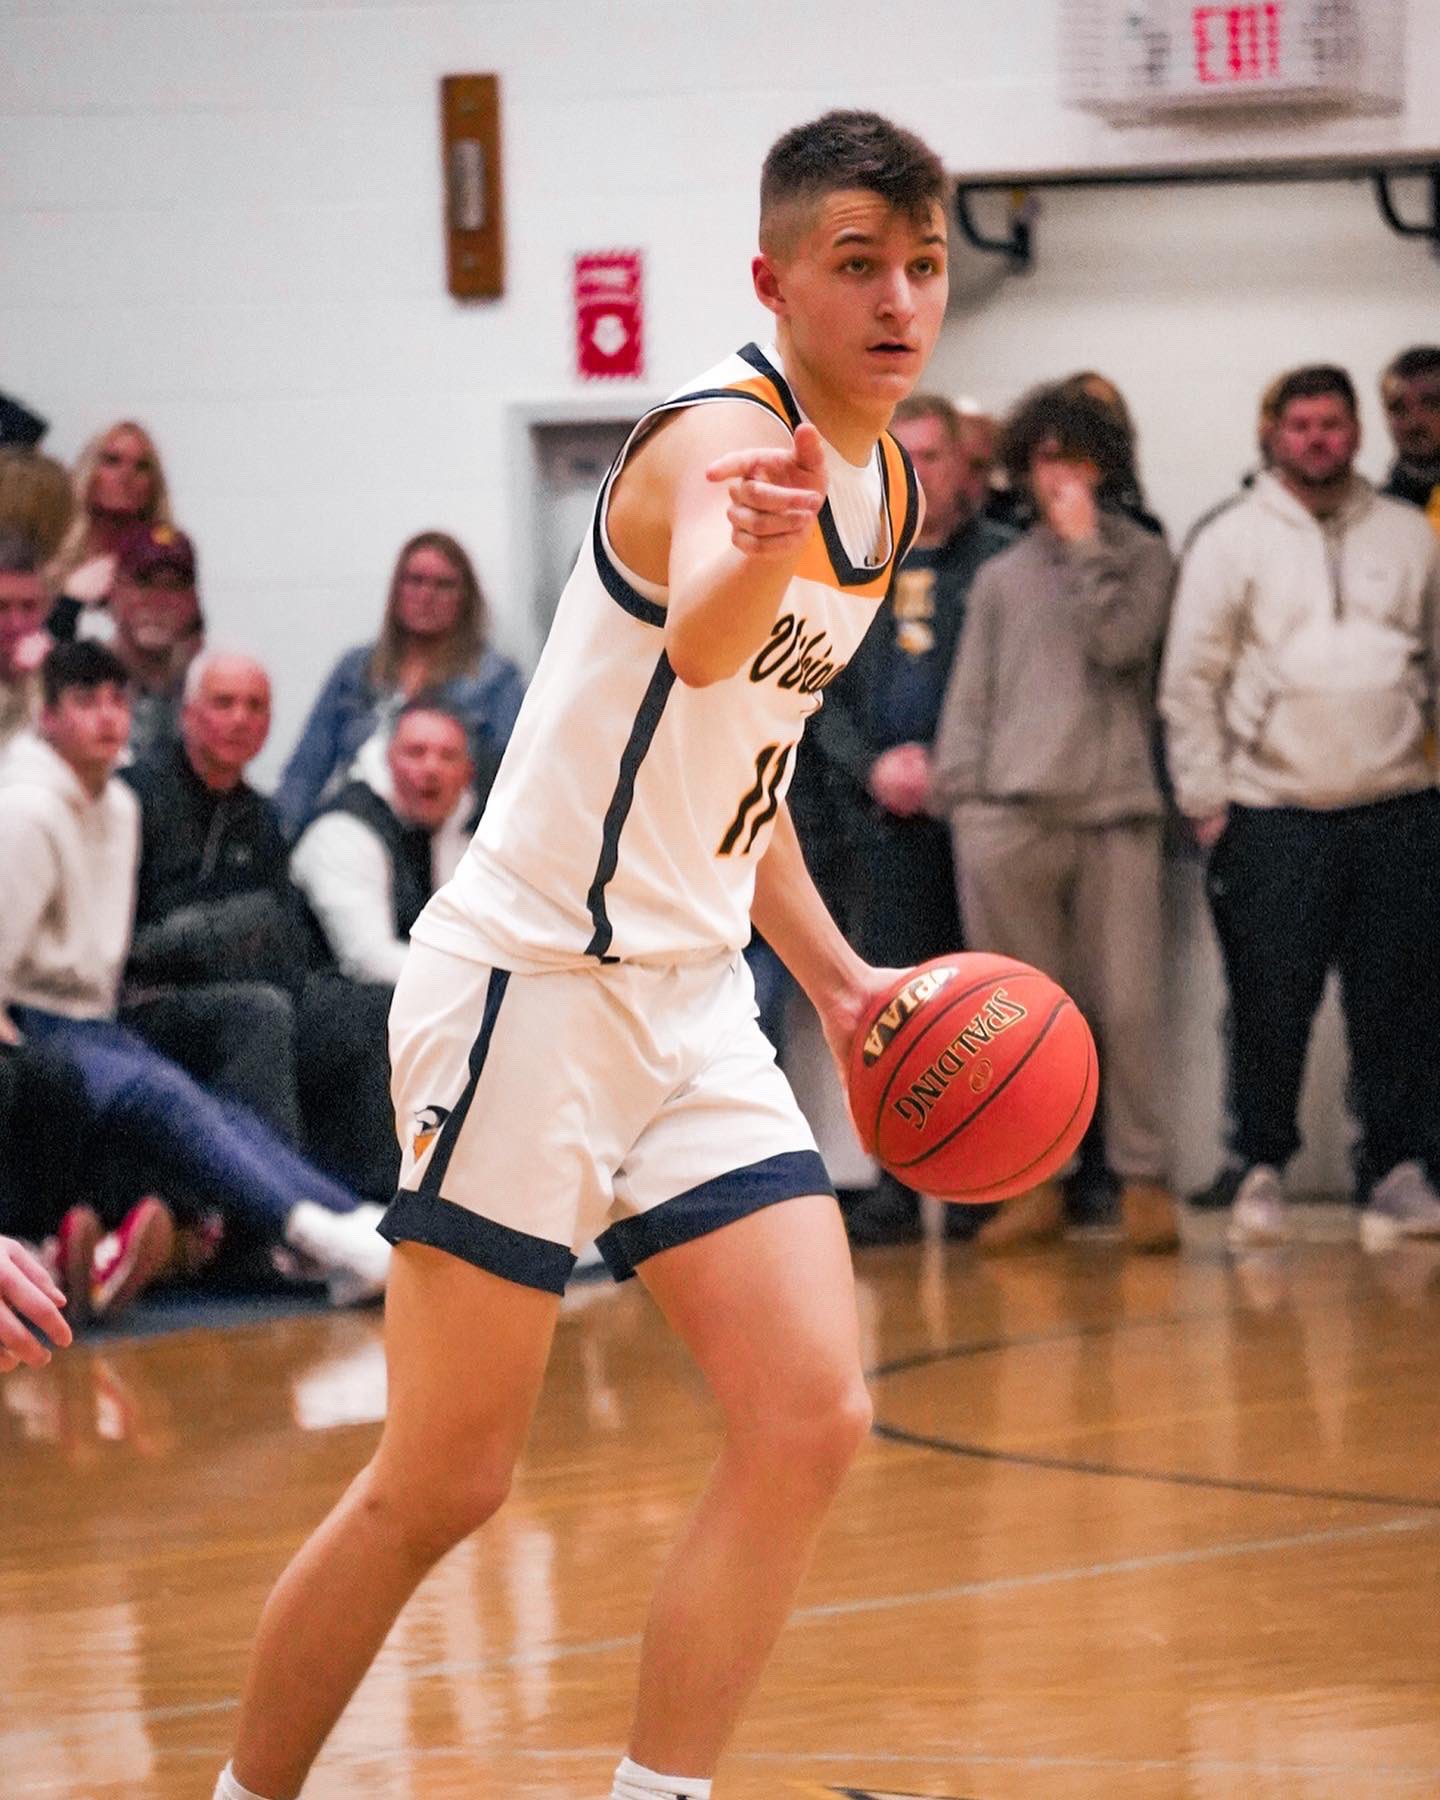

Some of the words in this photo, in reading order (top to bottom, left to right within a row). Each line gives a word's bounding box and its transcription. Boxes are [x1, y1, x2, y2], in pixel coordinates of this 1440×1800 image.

[750, 612, 846, 694] Vikin
[715, 741, 796, 858] 11
[863, 970, 942, 1057] PIAA
[893, 986, 1028, 1131] SPALDING
